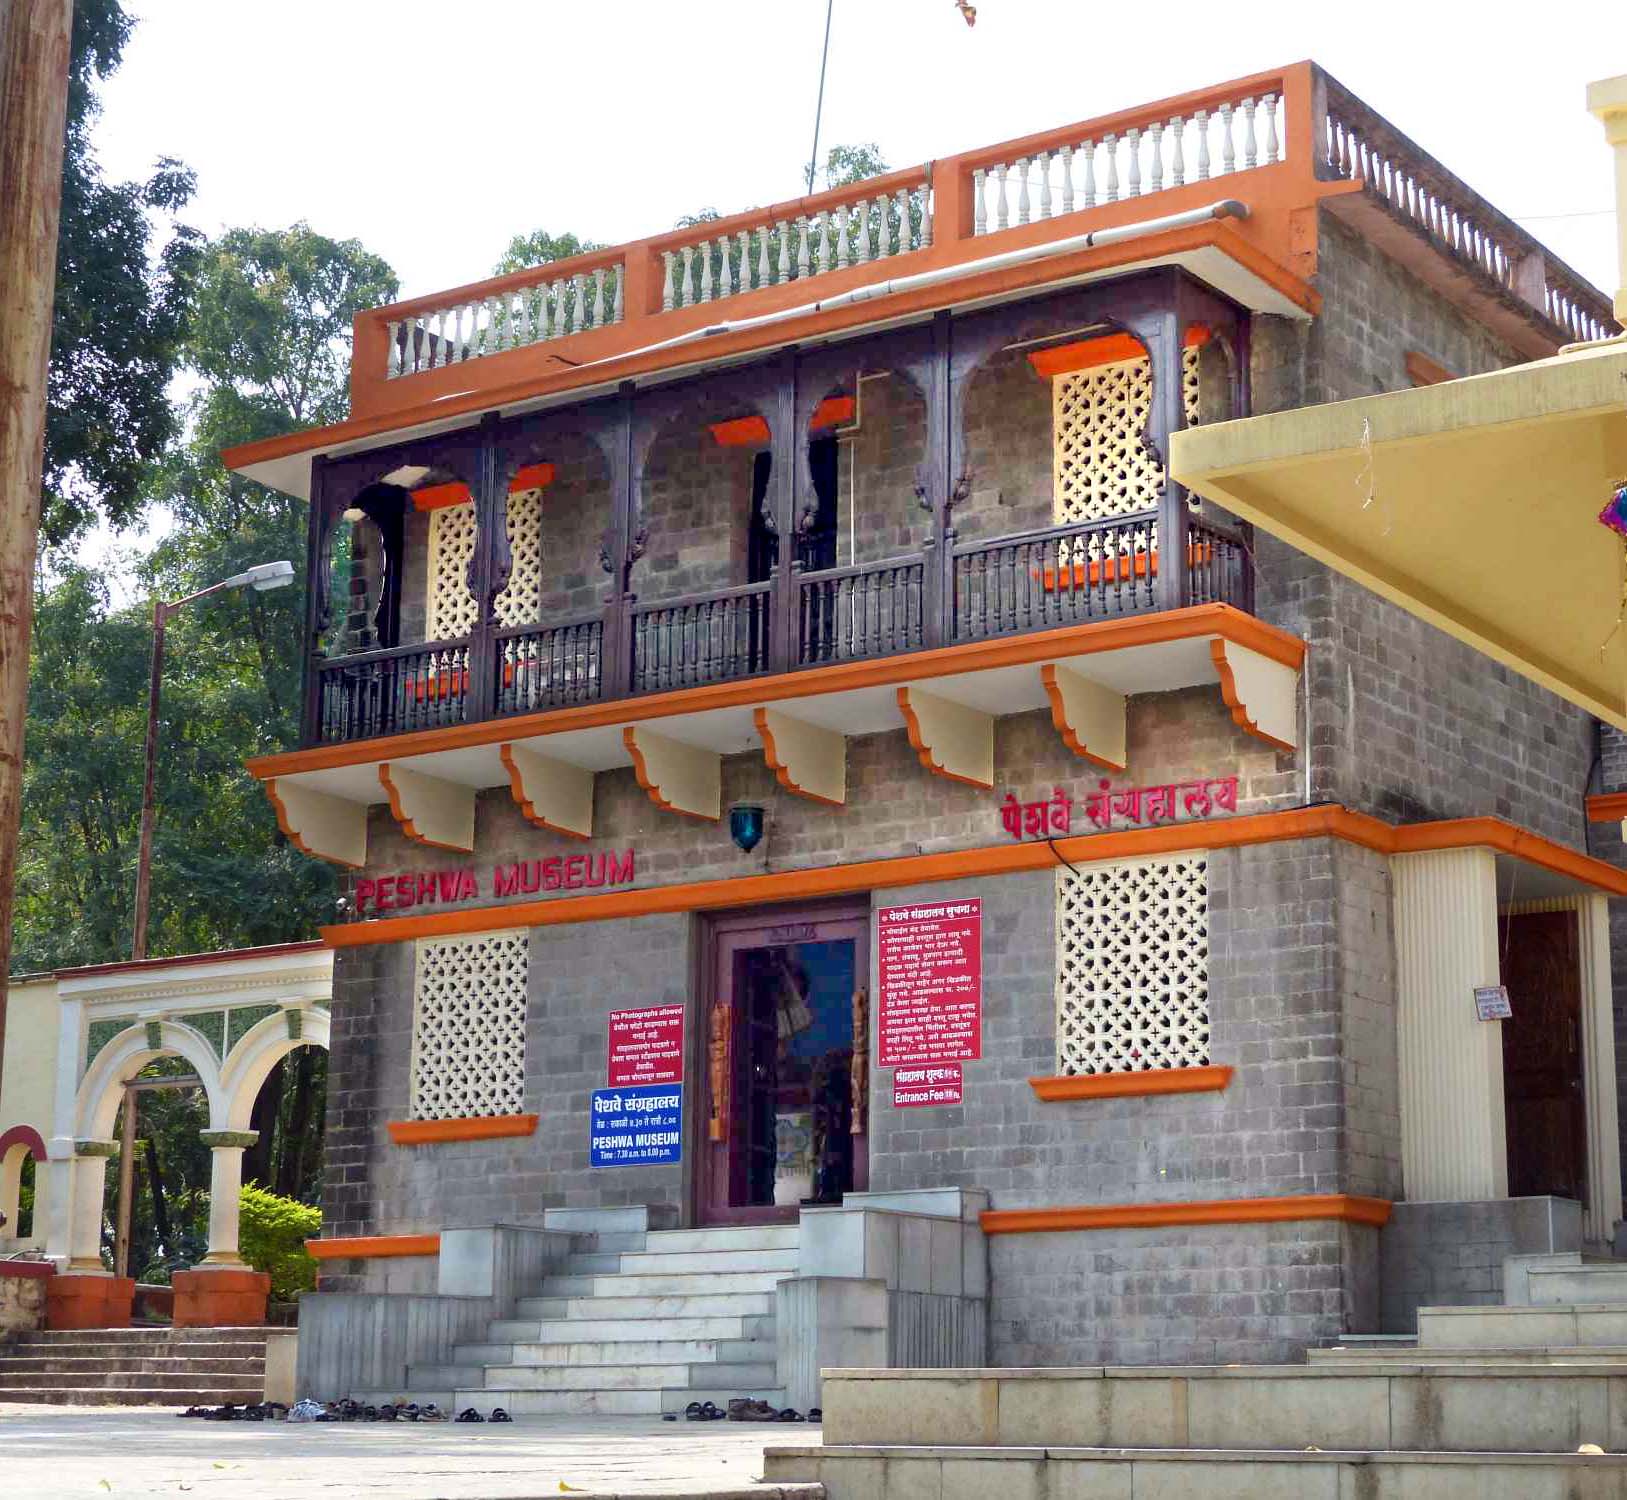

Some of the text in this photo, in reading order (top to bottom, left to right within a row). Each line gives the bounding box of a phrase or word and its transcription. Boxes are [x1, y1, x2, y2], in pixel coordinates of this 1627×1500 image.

[1001, 778, 1239, 841] पेशवे संग्रहालय
[356, 847, 635, 914] PESHWA MUSEUM
[659, 1007, 682, 1015] allowed
[595, 1093, 679, 1112] पेशवे संग्रहालय
[895, 1092, 928, 1103] Entrance
[929, 1090, 944, 1100] Fee
[593, 1132, 679, 1149] PESHWA MUSEUM
[600, 1151, 613, 1159] Time
